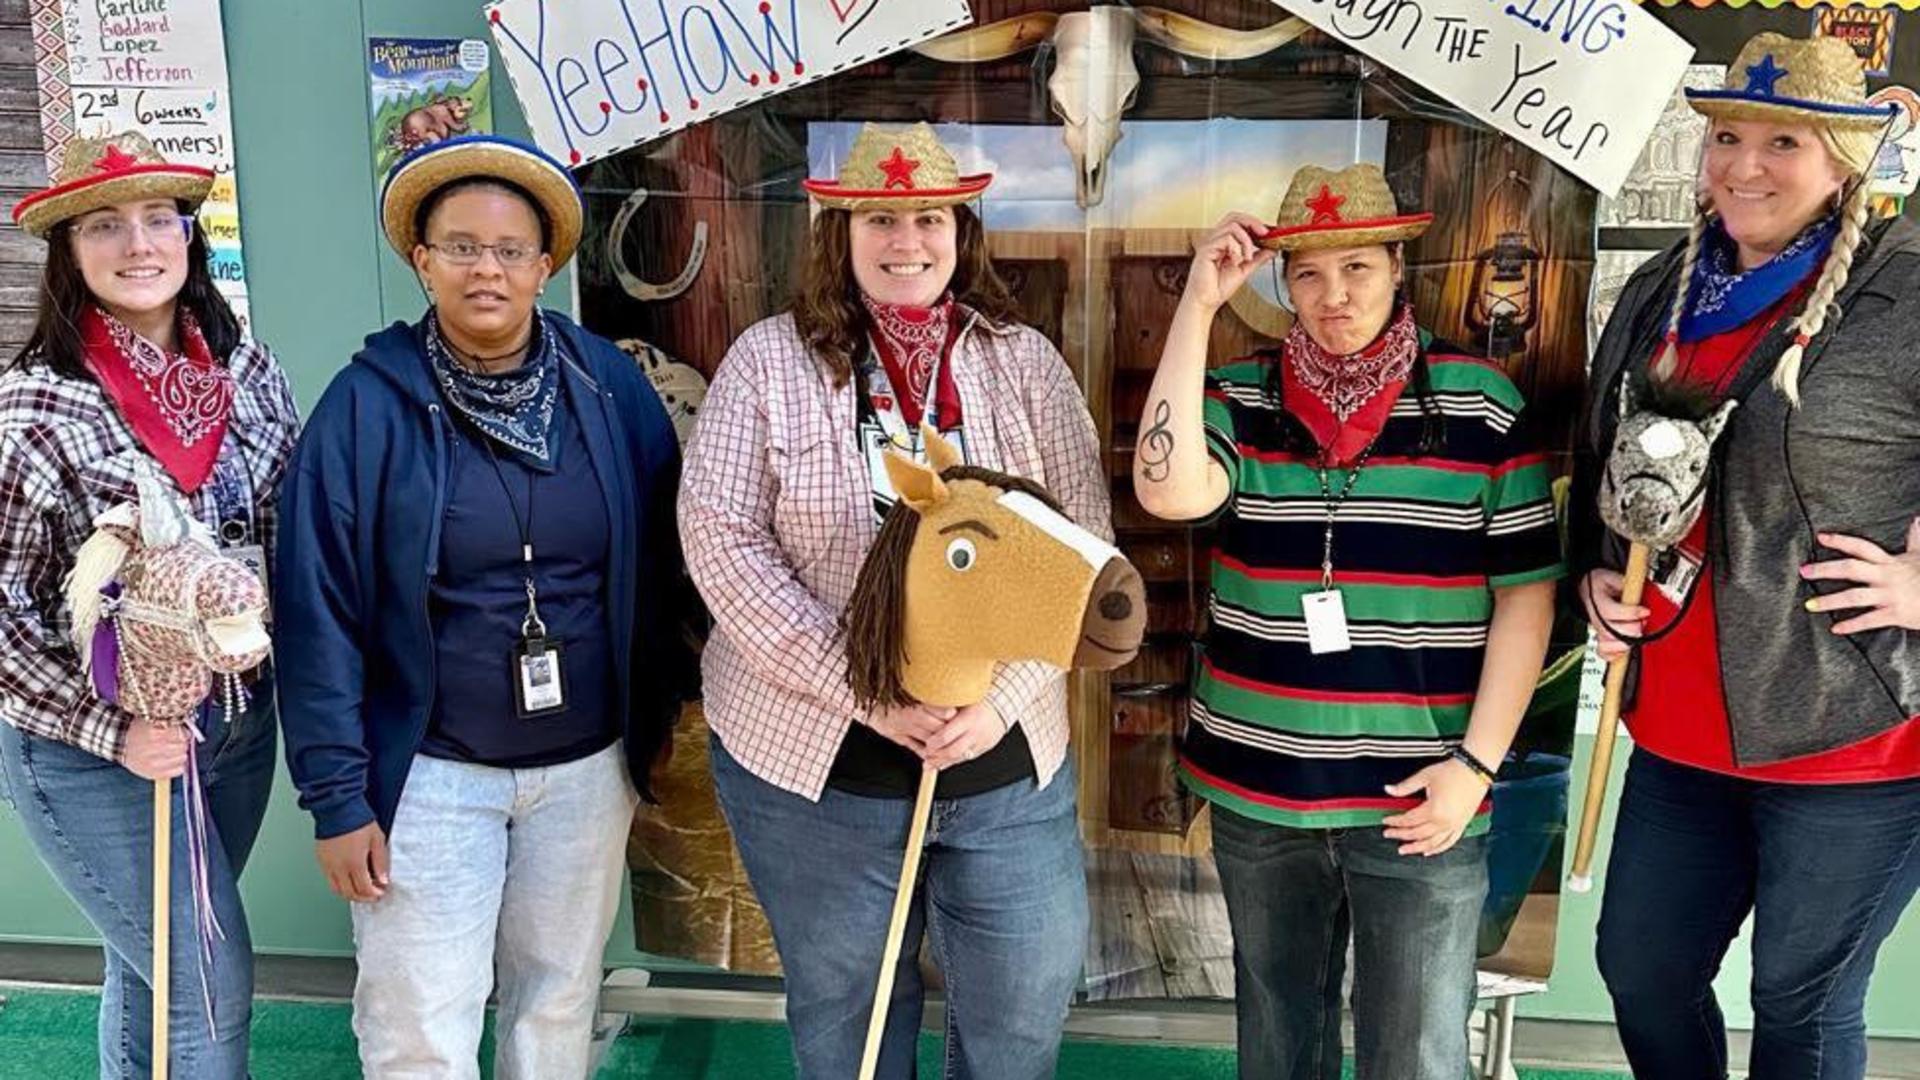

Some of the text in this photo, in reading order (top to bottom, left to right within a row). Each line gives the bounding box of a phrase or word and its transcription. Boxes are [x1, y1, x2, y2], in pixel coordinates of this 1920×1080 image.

[99, 15, 171, 38] Goddard
[1434, 16, 1489, 62] THE
[1504, 0, 1626, 53] ING
[99, 36, 163, 54] Lopez
[98, 56, 193, 82] Jefferson
[1491, 44, 1609, 160] Year
[151, 134, 224, 158] nners!
